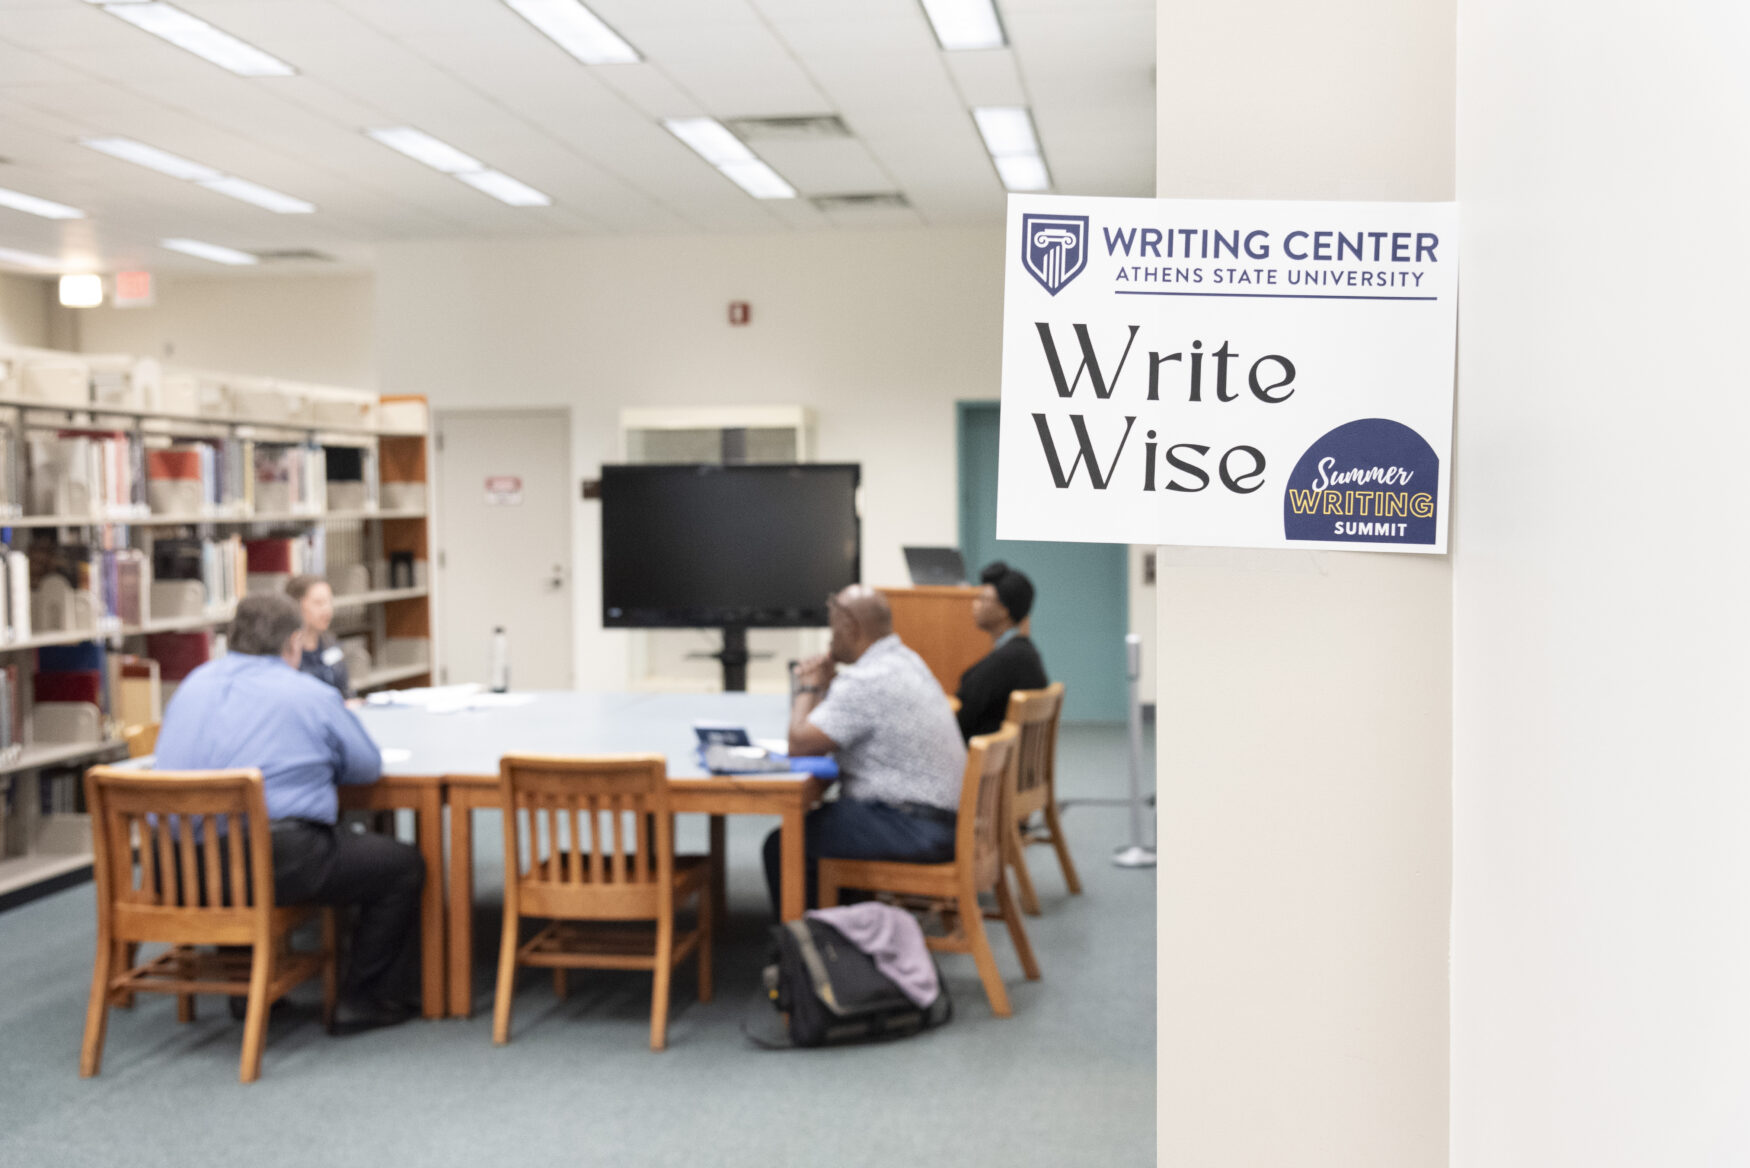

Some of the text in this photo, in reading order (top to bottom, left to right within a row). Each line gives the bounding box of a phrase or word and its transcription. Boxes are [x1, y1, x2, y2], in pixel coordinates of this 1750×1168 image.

[1103, 226, 1439, 263] WRITING CENTER
[1115, 266, 1425, 288] ATHENS STATE UNIVERSITY
[1034, 321, 1297, 404] Write
[1031, 412, 1267, 495] Wise
[1311, 456, 1414, 492] Summer
[1289, 489, 1434, 518] WRITING
[1334, 521, 1408, 537] SUMMIT
